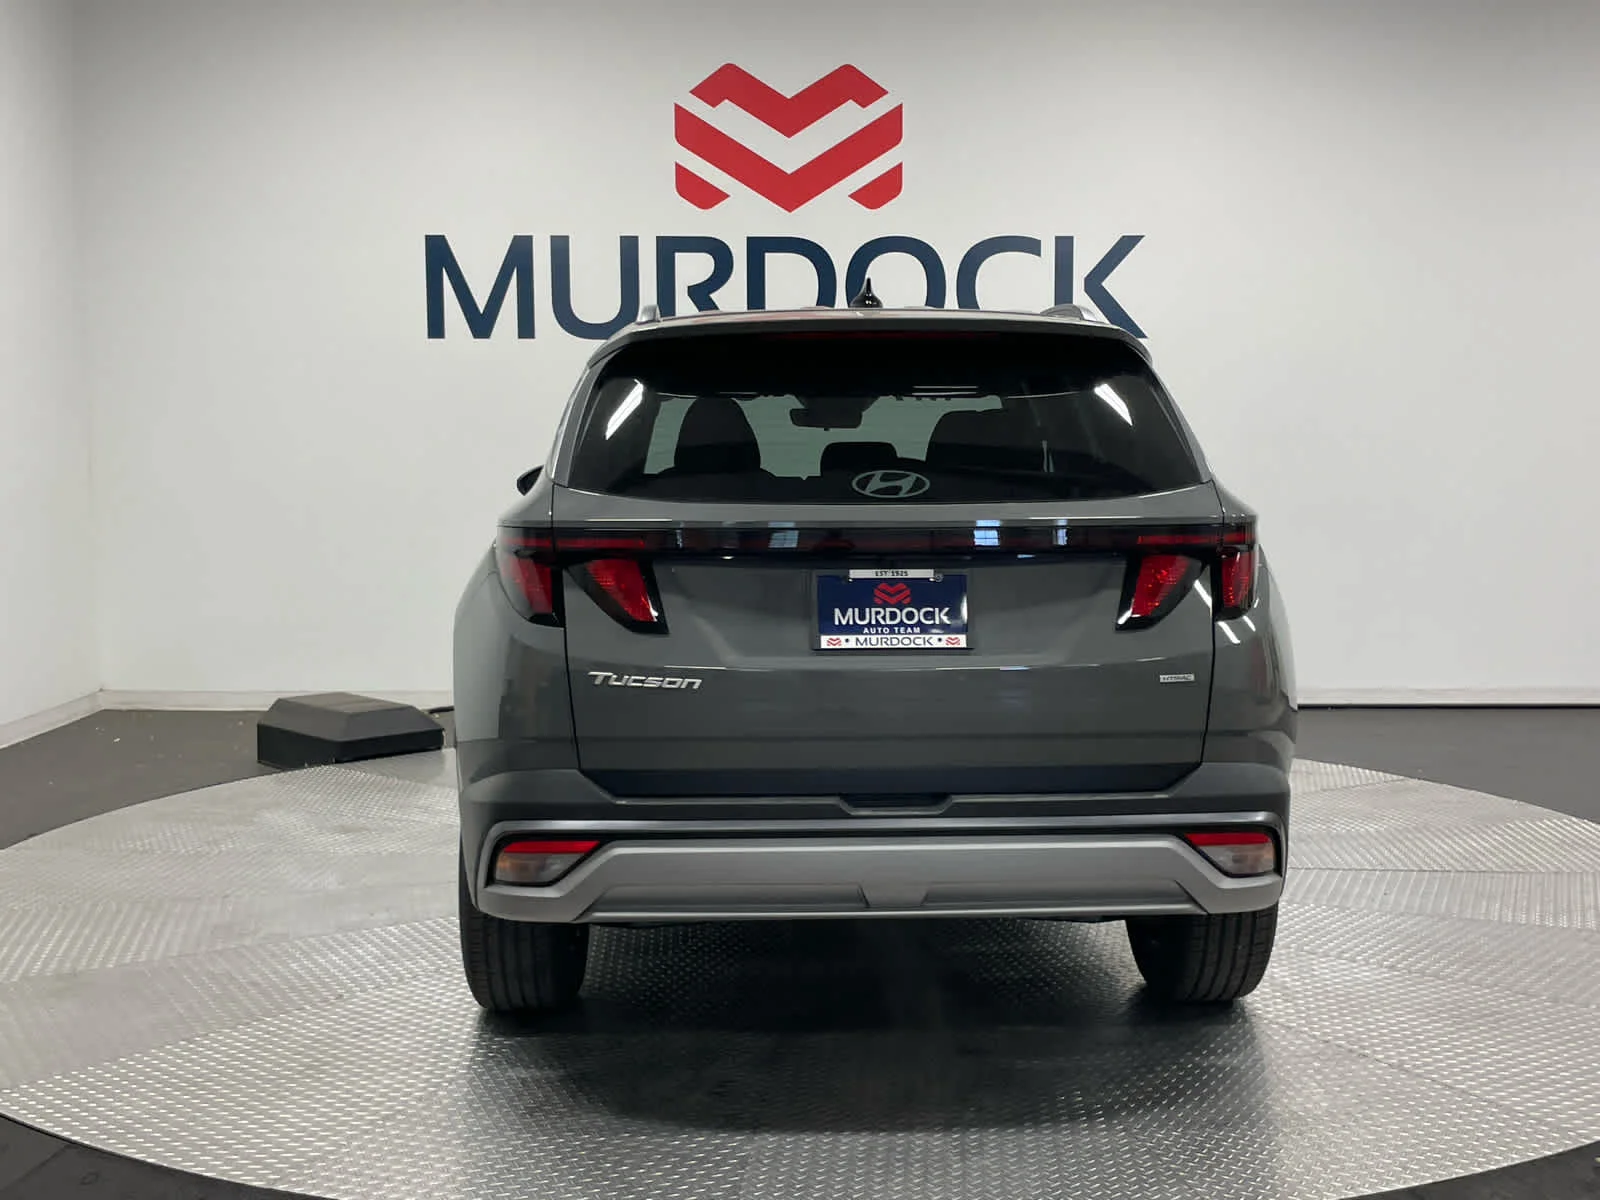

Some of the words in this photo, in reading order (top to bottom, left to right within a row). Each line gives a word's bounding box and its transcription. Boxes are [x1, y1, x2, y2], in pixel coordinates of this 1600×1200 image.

[424, 234, 1148, 339] MURDOCK
[834, 607, 951, 626] MURDOCK
[855, 636, 934, 646] MURDOCK
